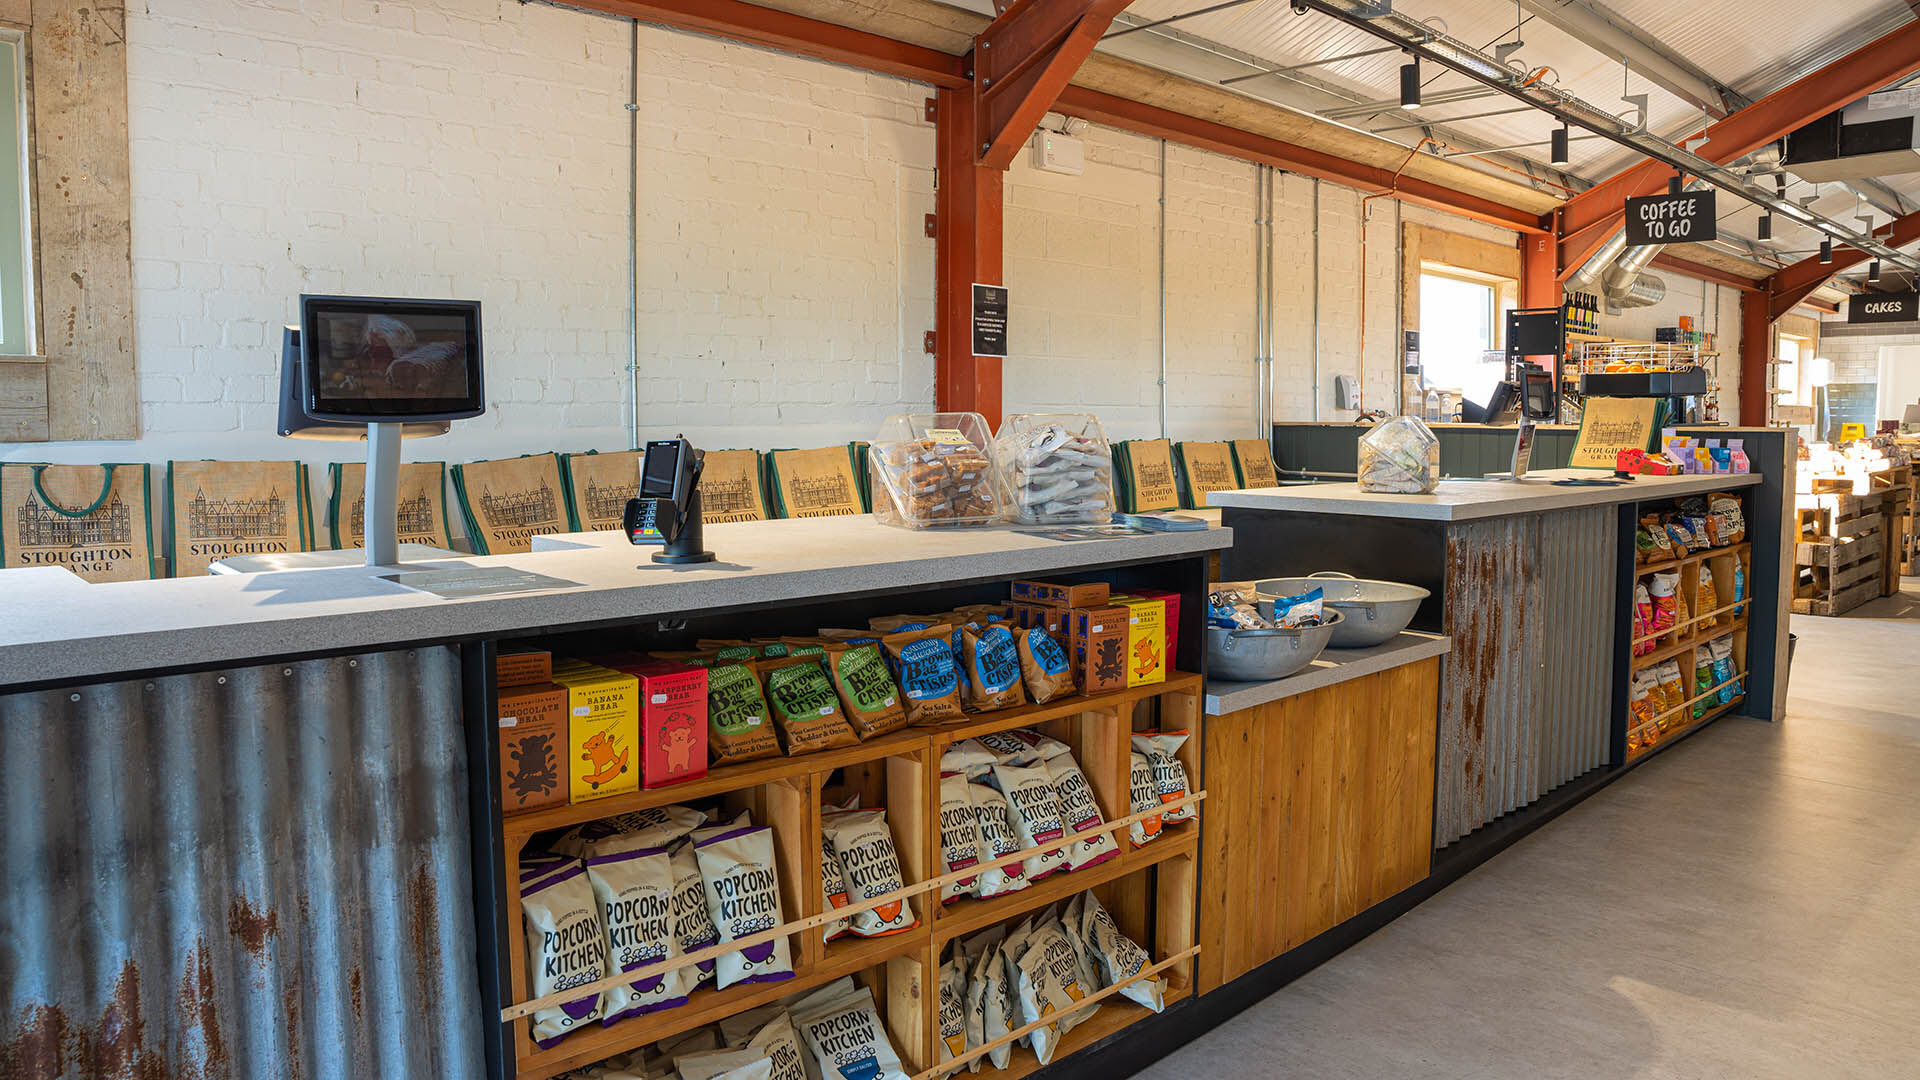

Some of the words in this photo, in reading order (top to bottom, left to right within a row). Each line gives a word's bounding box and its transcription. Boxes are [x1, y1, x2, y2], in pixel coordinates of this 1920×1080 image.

[1640, 199, 1697, 220] COFFEE
[1645, 220, 1665, 239] TO
[1668, 218, 1691, 237] GO
[1864, 300, 1903, 314] CAKES
[703, 512, 759, 524] TOUGHTON
[20, 548, 132, 565] STOUGHTON
[191, 541, 288, 556] STOUGHTON
[503, 703, 559, 718] CHOCOLATE
[587, 693, 624, 705] BANANA
[594, 702, 618, 712] BEAR
[839, 836, 895, 870] POPCORN
[713, 867, 775, 900] POPCORN
[849, 856, 900, 889] KITCHEN
[606, 895, 670, 926] POPCORN
[721, 890, 777, 921] KITCHEN
[543, 913, 601, 954] POPCORN
[609, 916, 670, 950] KITCHEN
[546, 938, 604, 978] KITCHEN
[810, 1010, 870, 1041] POPCORN
[820, 1025, 876, 1057] KITCHEN
